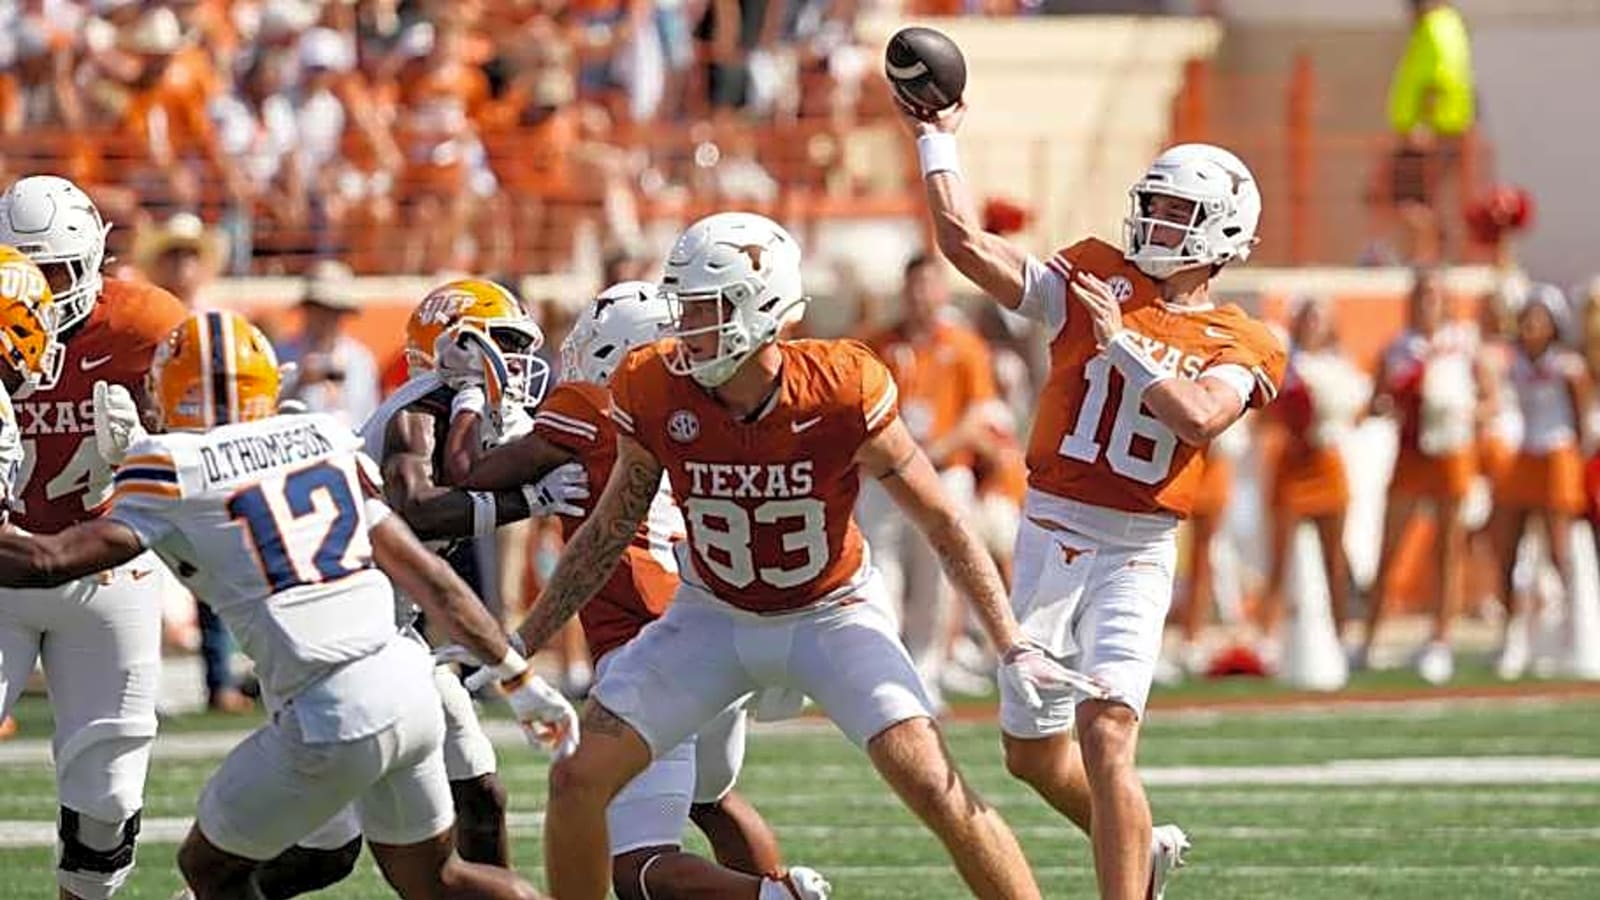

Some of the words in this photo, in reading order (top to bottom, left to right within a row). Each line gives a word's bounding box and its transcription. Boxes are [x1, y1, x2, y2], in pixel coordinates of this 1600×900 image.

[12, 400, 97, 434] XAS
[201, 423, 334, 484] D.THOMPSON
[1059, 355, 1178, 485] 16
[685, 460, 814, 498] TEXAS
[225, 458, 371, 595] 12
[684, 497, 830, 589] 83
